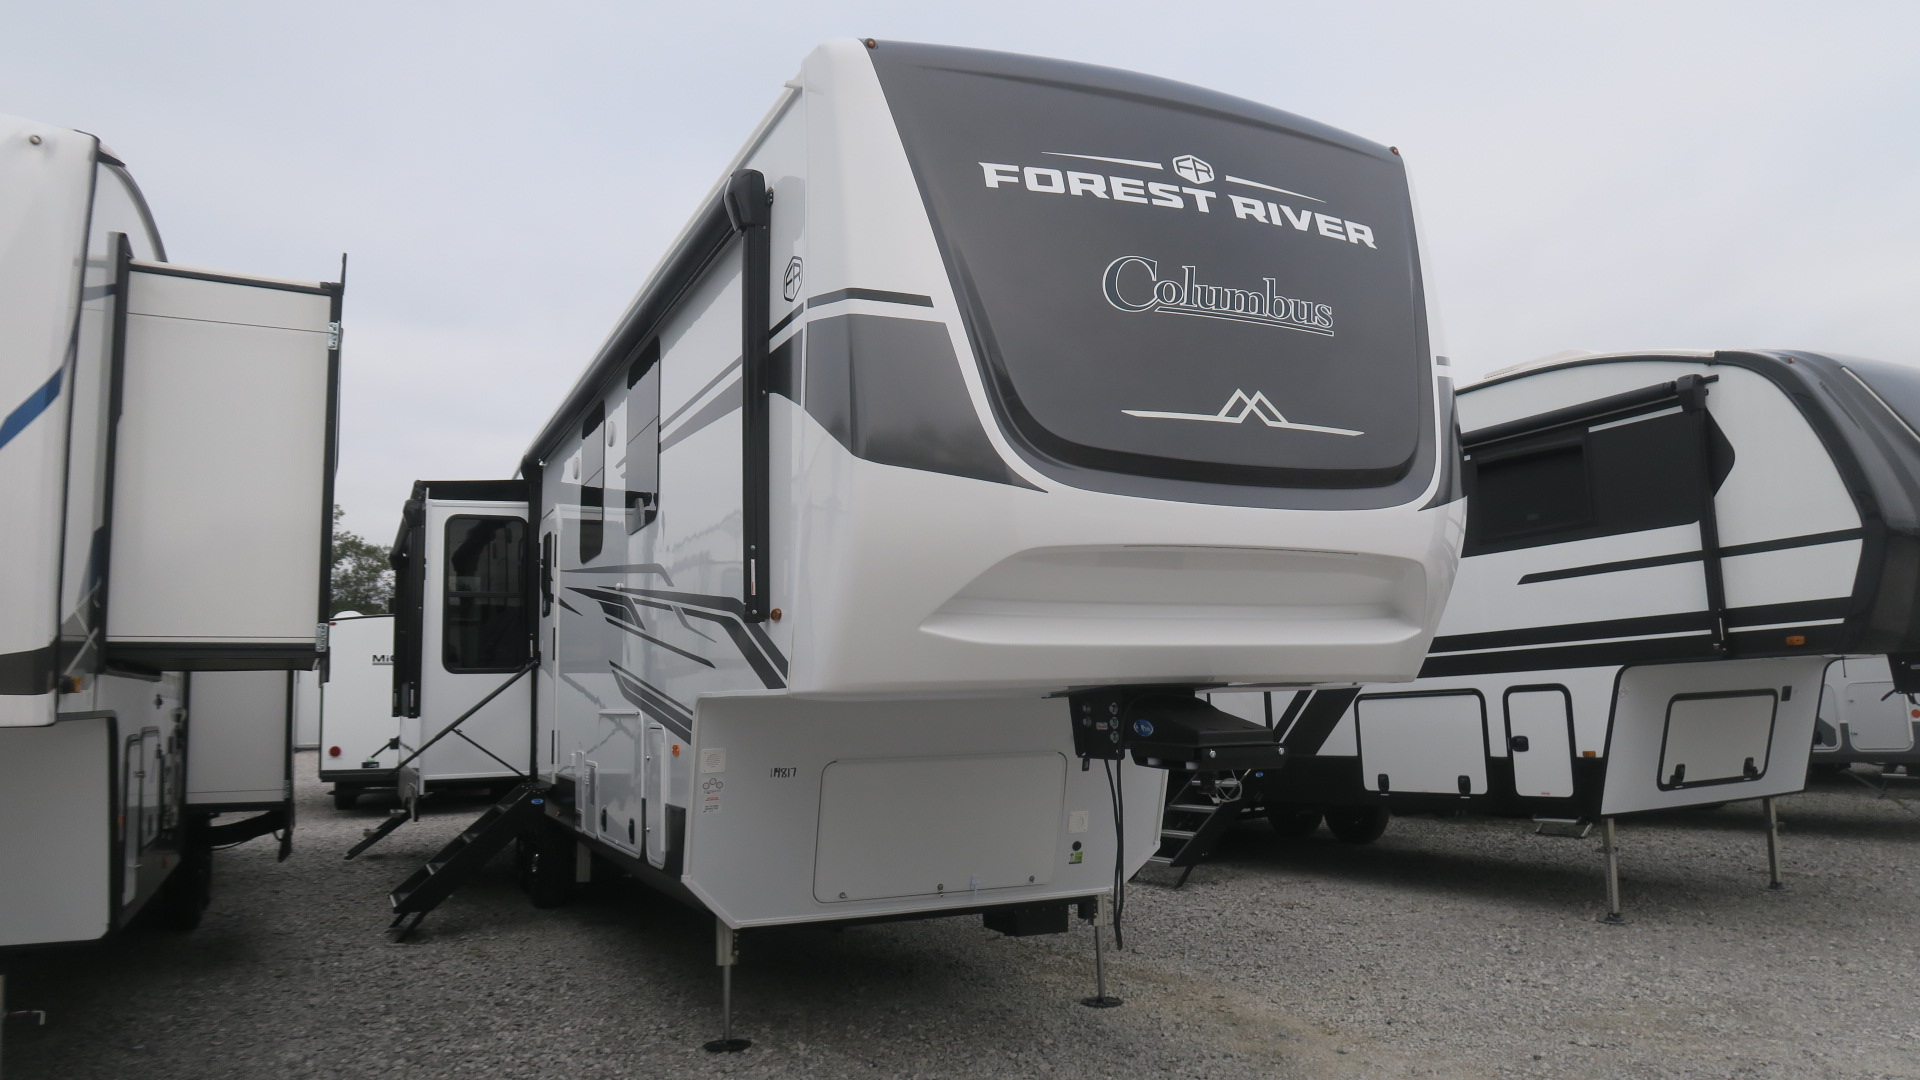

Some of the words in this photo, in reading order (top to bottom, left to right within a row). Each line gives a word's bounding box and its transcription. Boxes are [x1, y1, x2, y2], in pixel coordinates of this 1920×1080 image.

[978, 162, 1217, 213] FOREST
[1228, 194, 1378, 249] RIVER
[1102, 255, 1334, 329] Columbus
